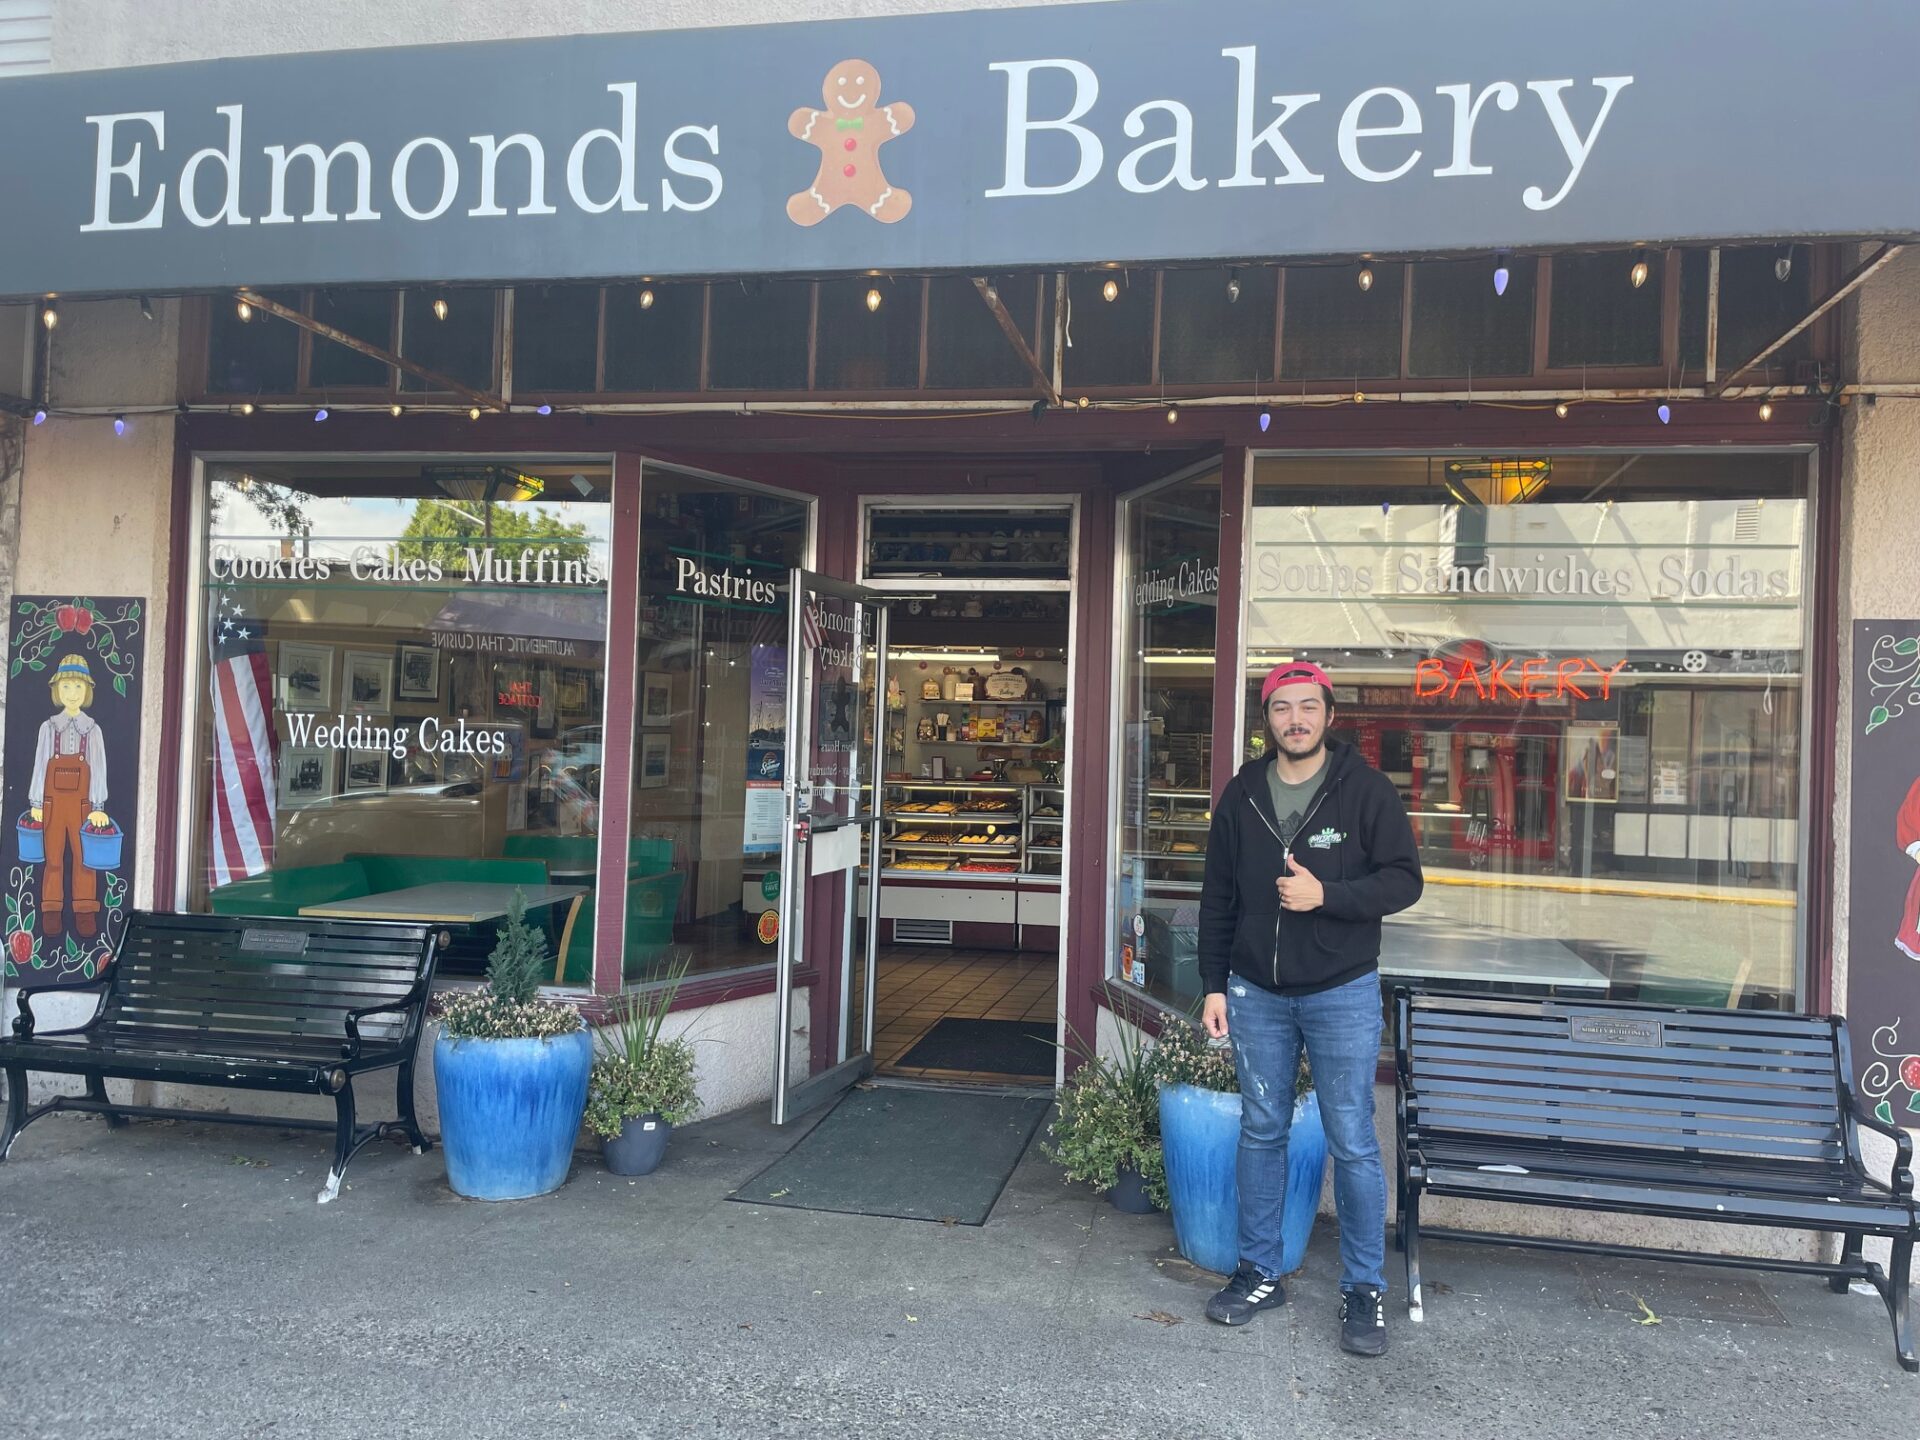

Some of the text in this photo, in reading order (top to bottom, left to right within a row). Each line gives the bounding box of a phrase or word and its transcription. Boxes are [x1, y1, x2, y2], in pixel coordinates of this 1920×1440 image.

[80, 45, 1634, 232] Edmonds Bakery
[208, 544, 602, 584] Cookies Cakes Muffins
[676, 557, 776, 604] Pastries
[1123, 558, 1219, 609] Wedding Cakes
[1257, 551, 1790, 599] Soups Sandwiches Sodas
[1414, 657, 1628, 701] BAKERY
[286, 713, 506, 759] Wedding Cakes
[764, 883, 779, 892] FAVE
